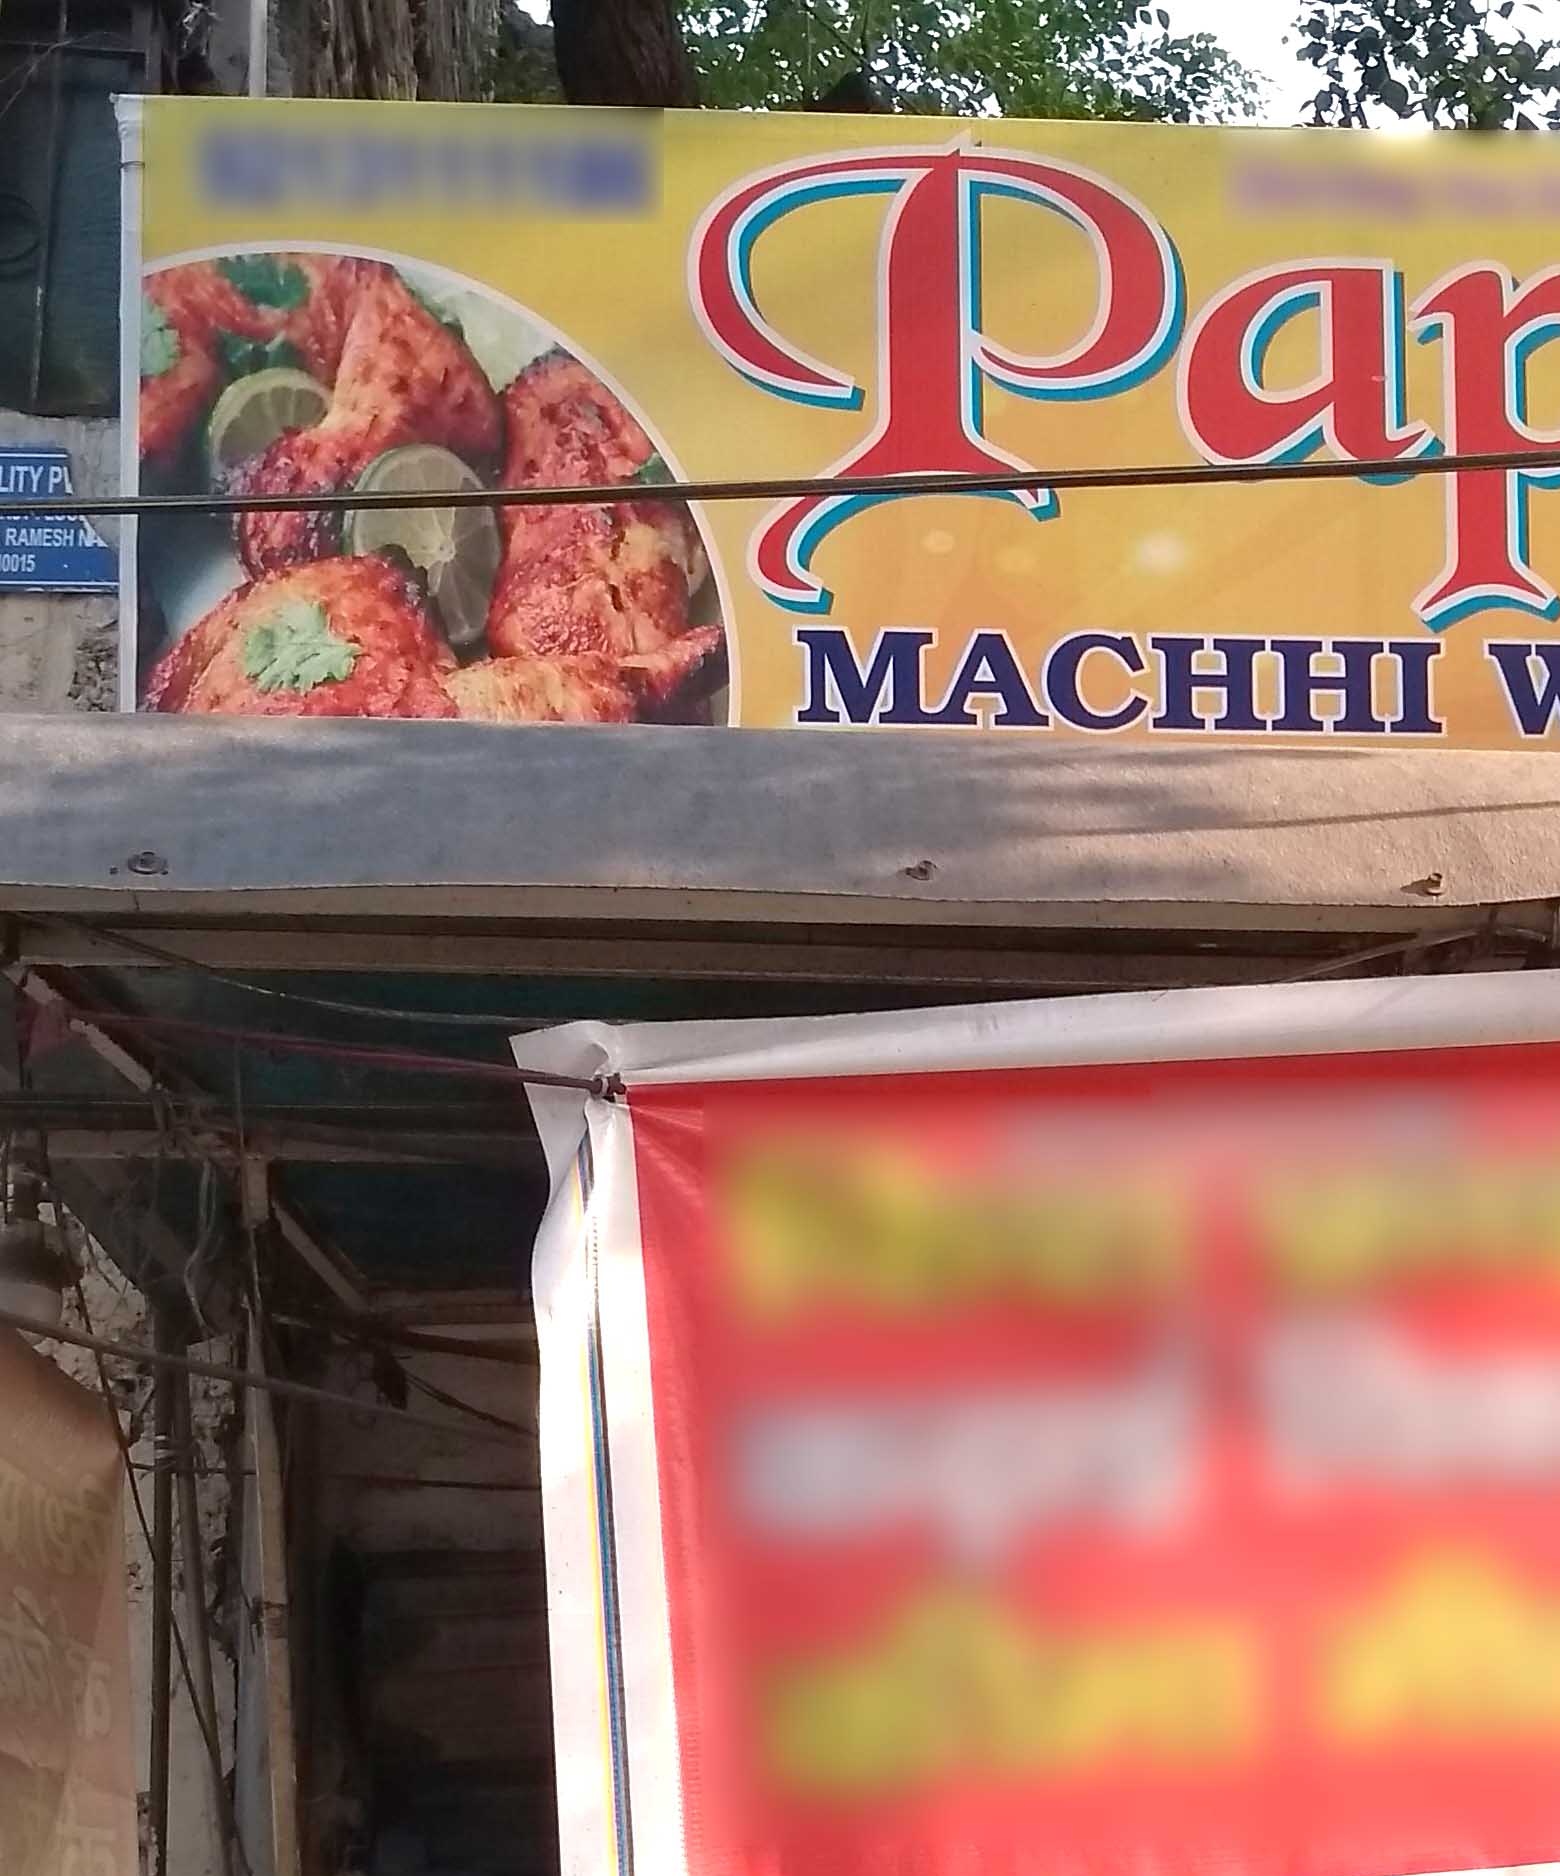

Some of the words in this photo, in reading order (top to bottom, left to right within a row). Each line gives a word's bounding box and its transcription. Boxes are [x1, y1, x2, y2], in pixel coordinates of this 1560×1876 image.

[5, 527, 75, 548] RAMESH
[0, 553, 36, 573] 0015
[794, 627, 1443, 736] MACHHI
